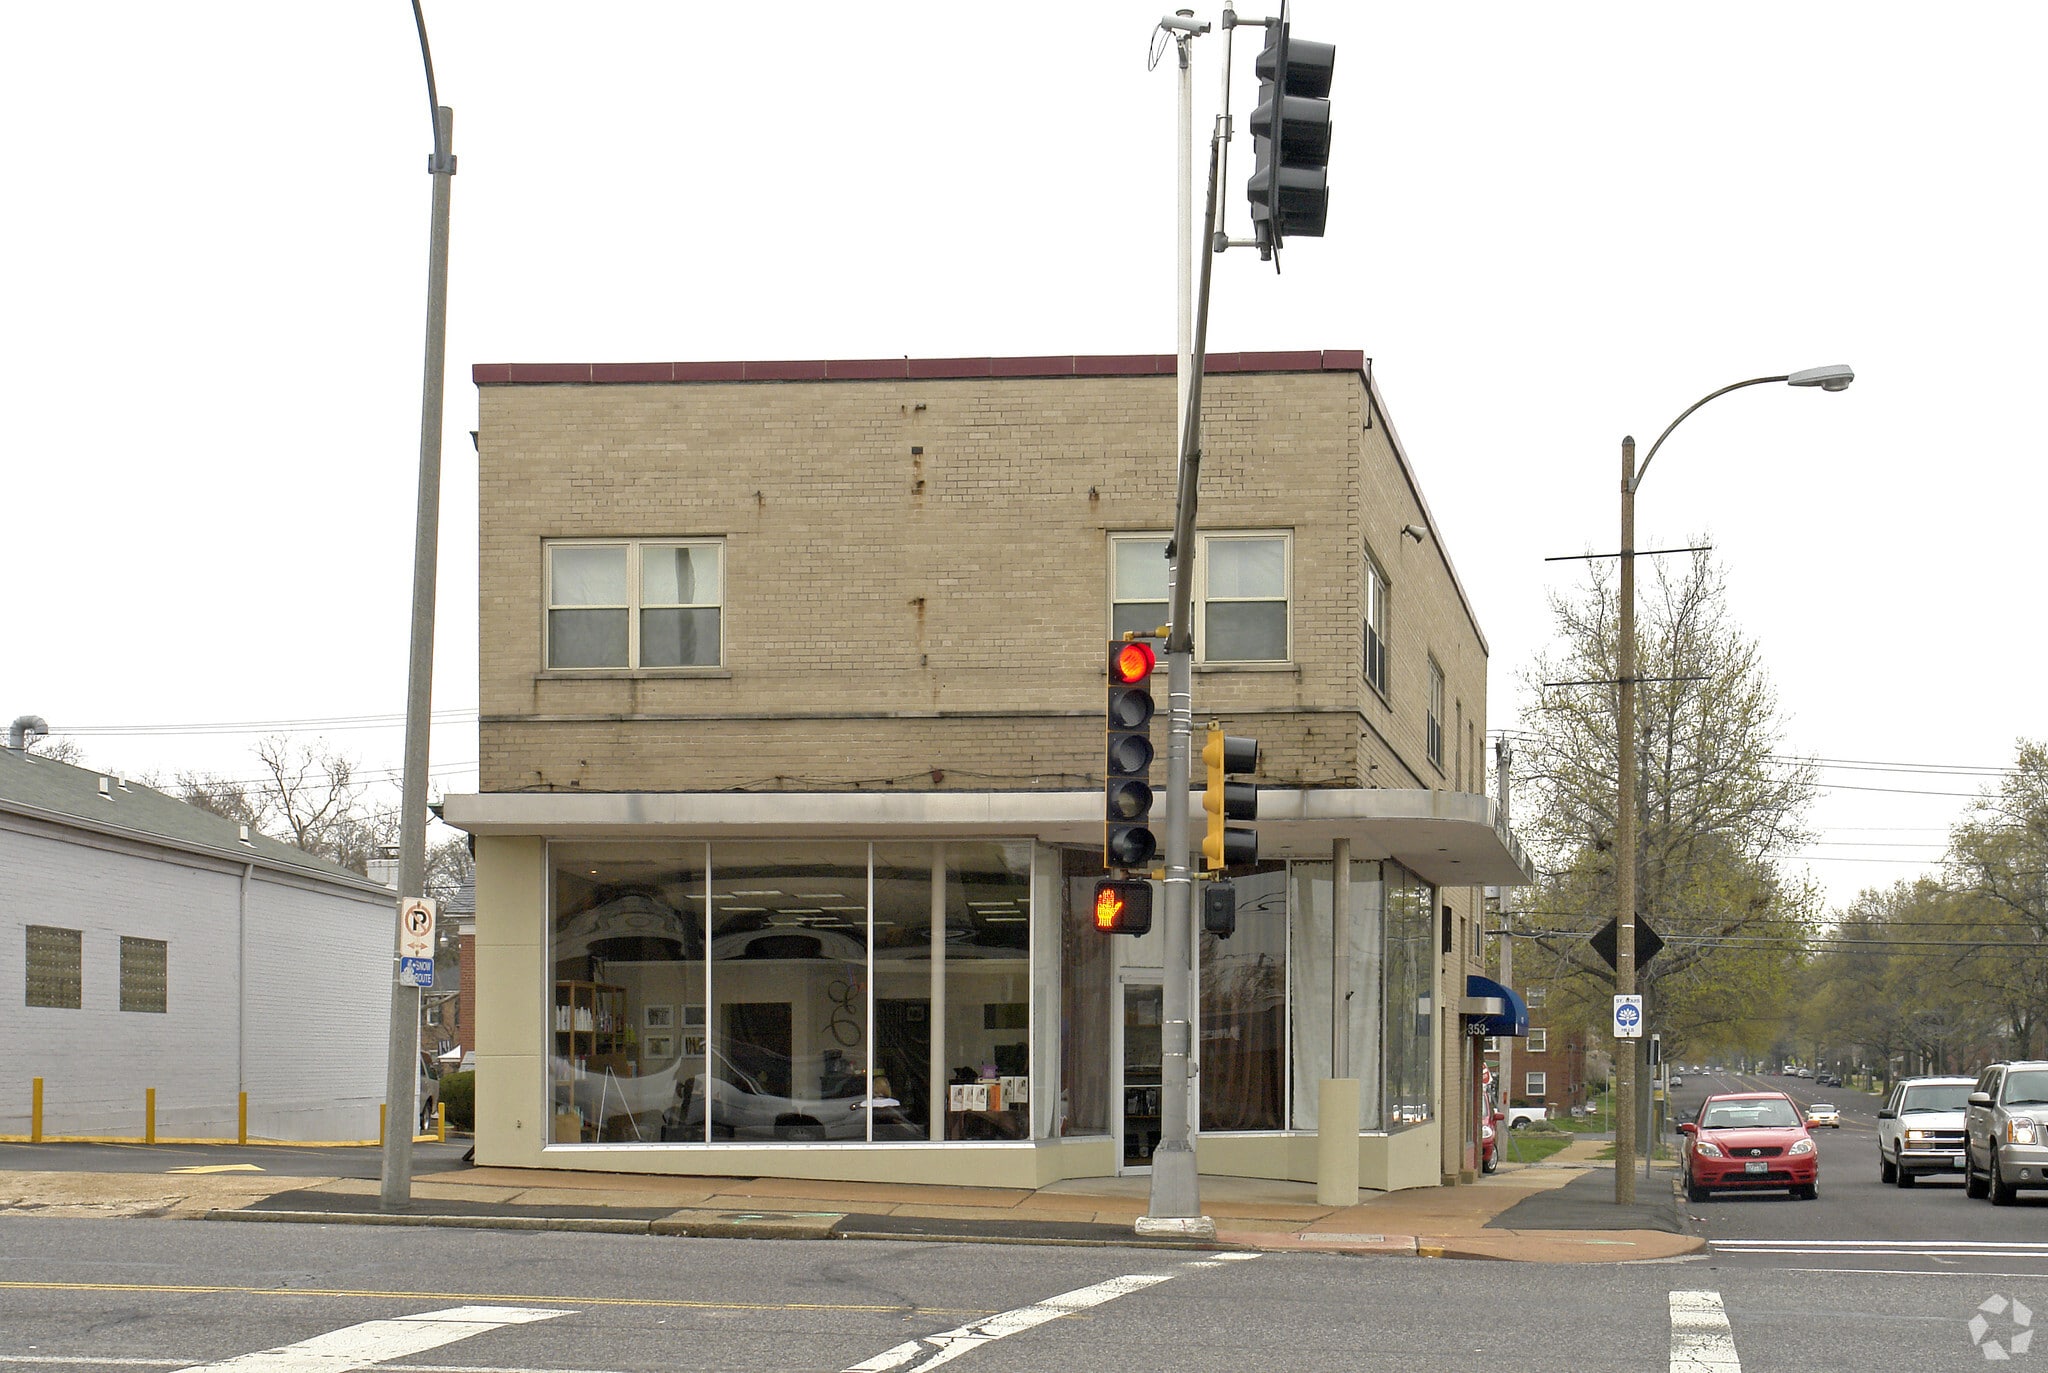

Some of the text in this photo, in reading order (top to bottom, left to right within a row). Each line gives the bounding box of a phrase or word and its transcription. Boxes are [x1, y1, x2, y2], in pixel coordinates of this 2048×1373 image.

[413, 911, 427, 931] P
[415, 960, 432, 971] SNOW
[415, 973, 432, 983] ROUTE
